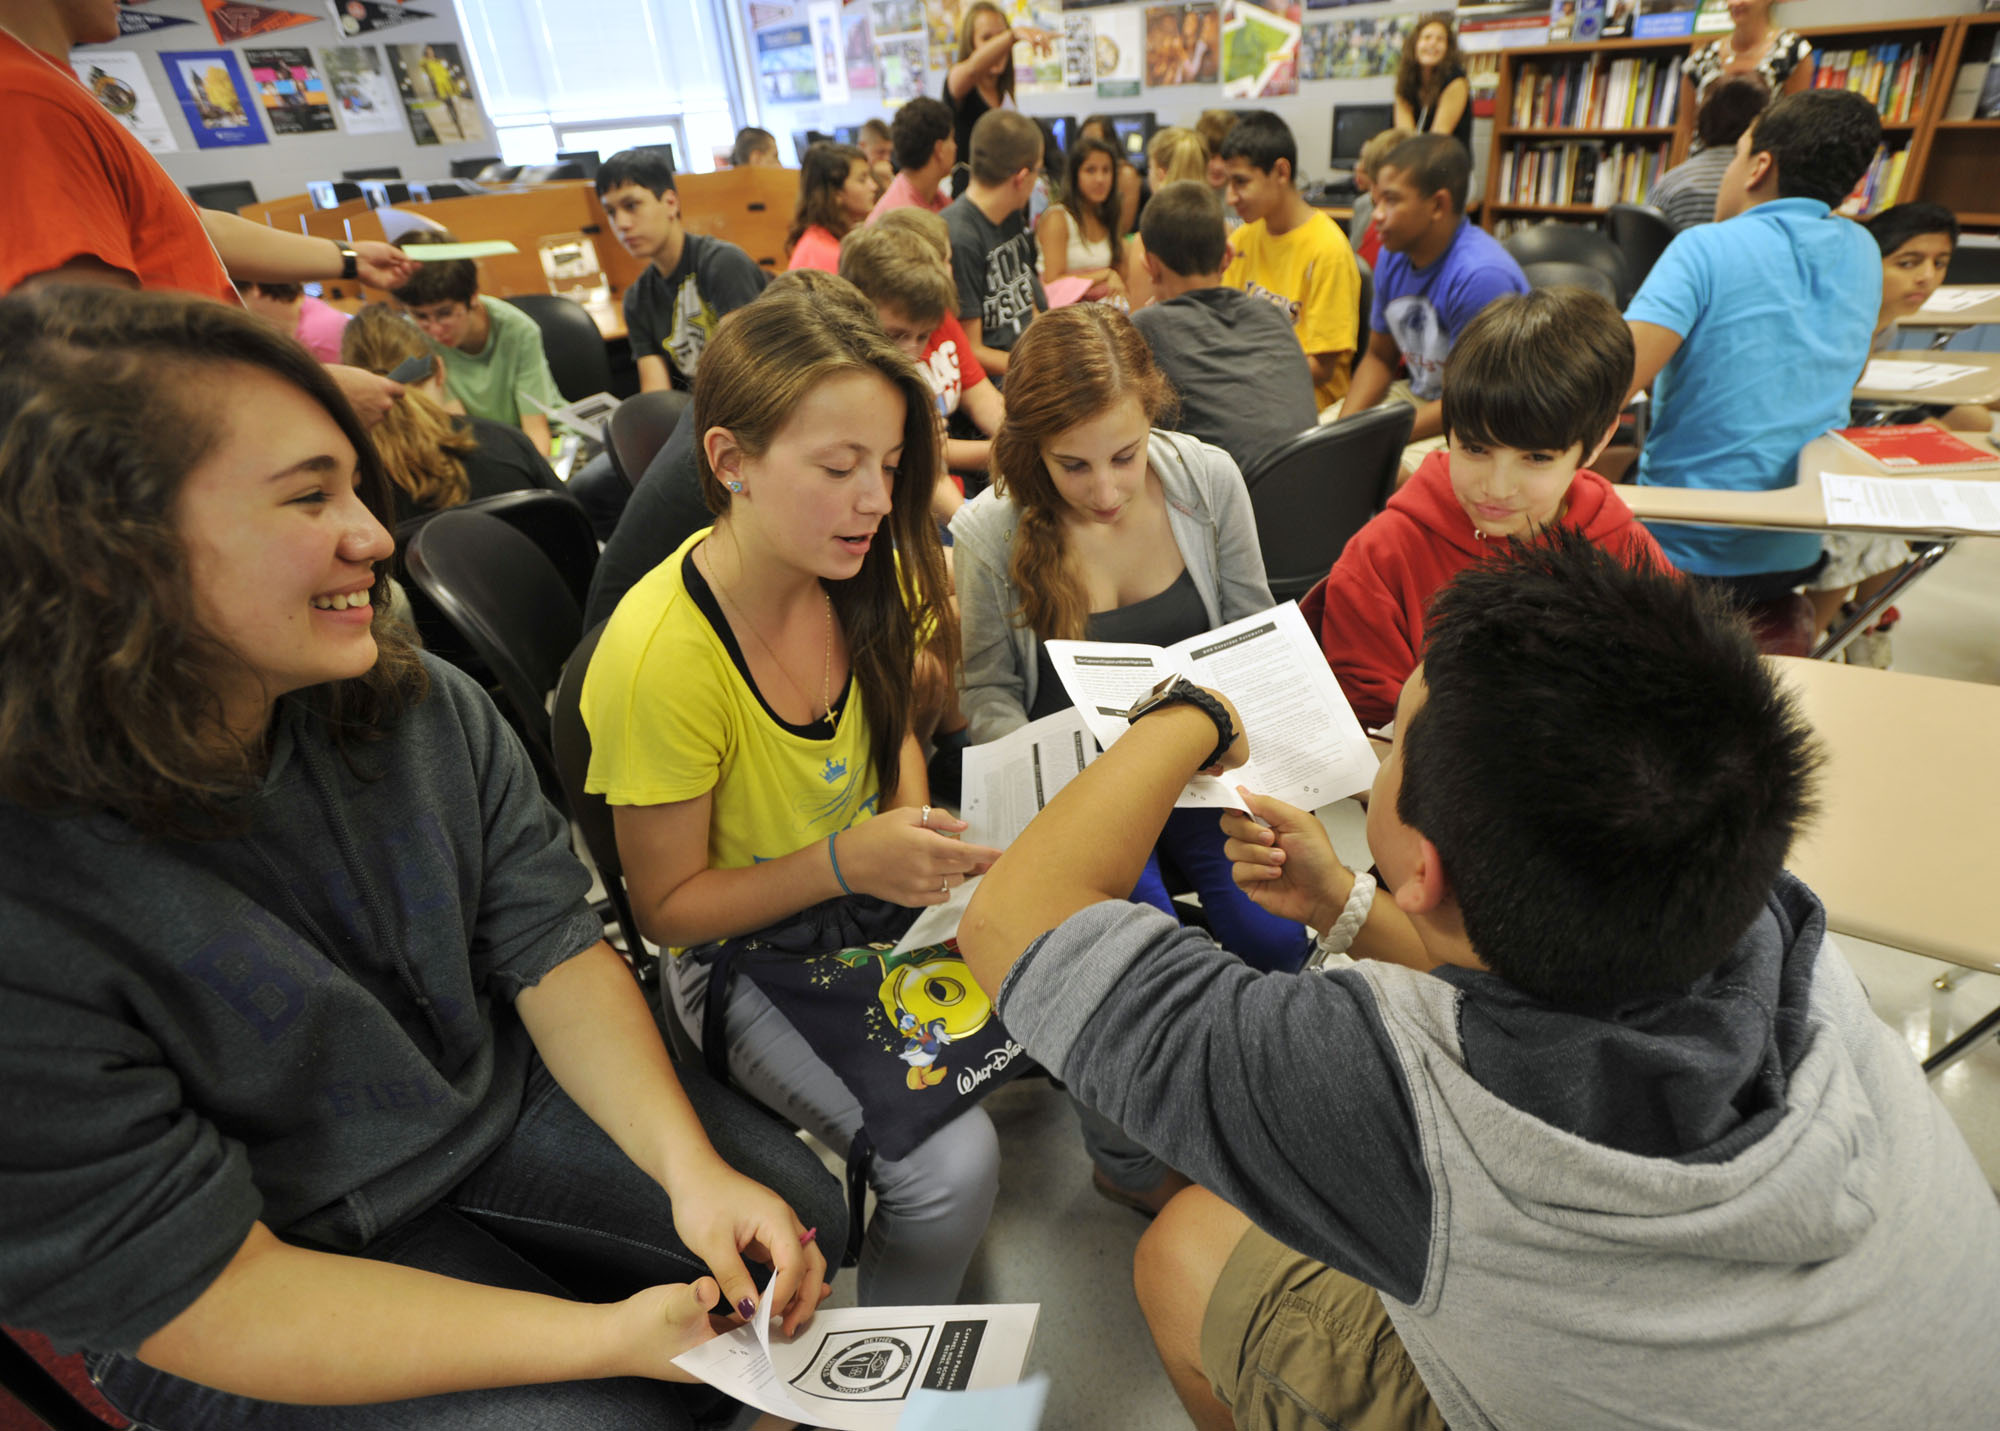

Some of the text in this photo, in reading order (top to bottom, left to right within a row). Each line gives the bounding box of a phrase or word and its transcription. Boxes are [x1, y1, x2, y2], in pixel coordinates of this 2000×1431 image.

[863, 1336, 893, 1344] BETHEL
[949, 1331, 960, 1351] BETHEL
[935, 1366, 942, 1375] CT
[936, 1365, 949, 1388] SCHOOL
[836, 1385, 871, 1394] SCHOOL
